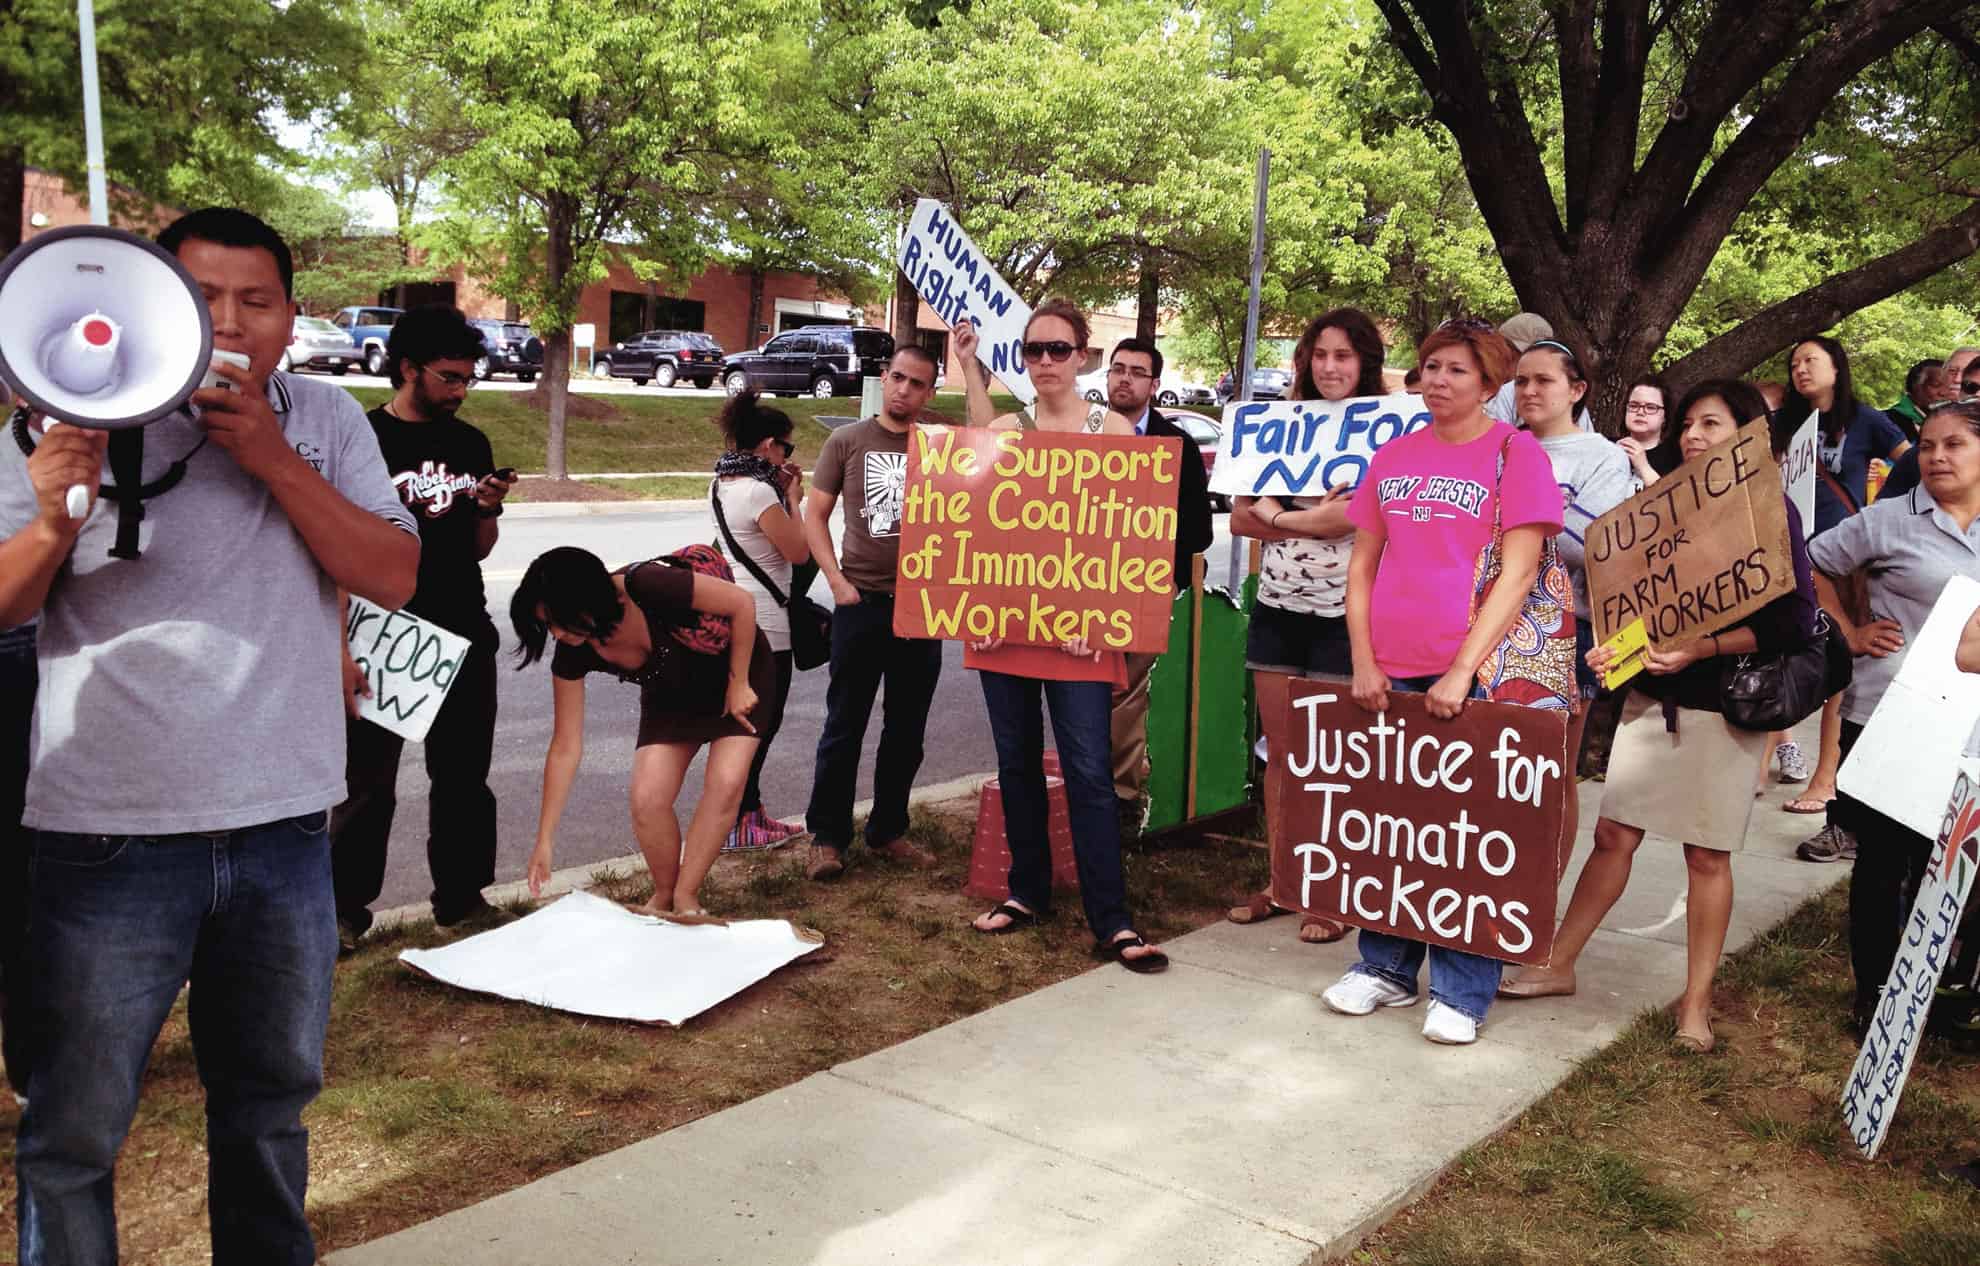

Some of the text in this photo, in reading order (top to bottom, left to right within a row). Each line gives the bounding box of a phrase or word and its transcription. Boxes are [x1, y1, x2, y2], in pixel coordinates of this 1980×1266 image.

[927, 208, 1012, 317] HUMAN
[1231, 402, 1330, 458] Fair
[916, 430, 1174, 495] We Support
[905, 479, 1178, 541] the Coalition
[1413, 505, 1431, 521] NJ
[1417, 476, 1489, 518] JERSEY
[1593, 436, 1760, 562] JUSTICE
[901, 530, 1172, 594] of Immokalee
[1645, 528, 1691, 568] FOR
[919, 587, 1134, 648] Workers
[1603, 563, 1678, 635] FARM
[1287, 694, 1561, 807] Justice for
[1304, 782, 1516, 876] Tomato
[1293, 843, 1533, 954] Pickers
[1908, 907, 1930, 948] in
[1925, 890, 1960, 974] End
